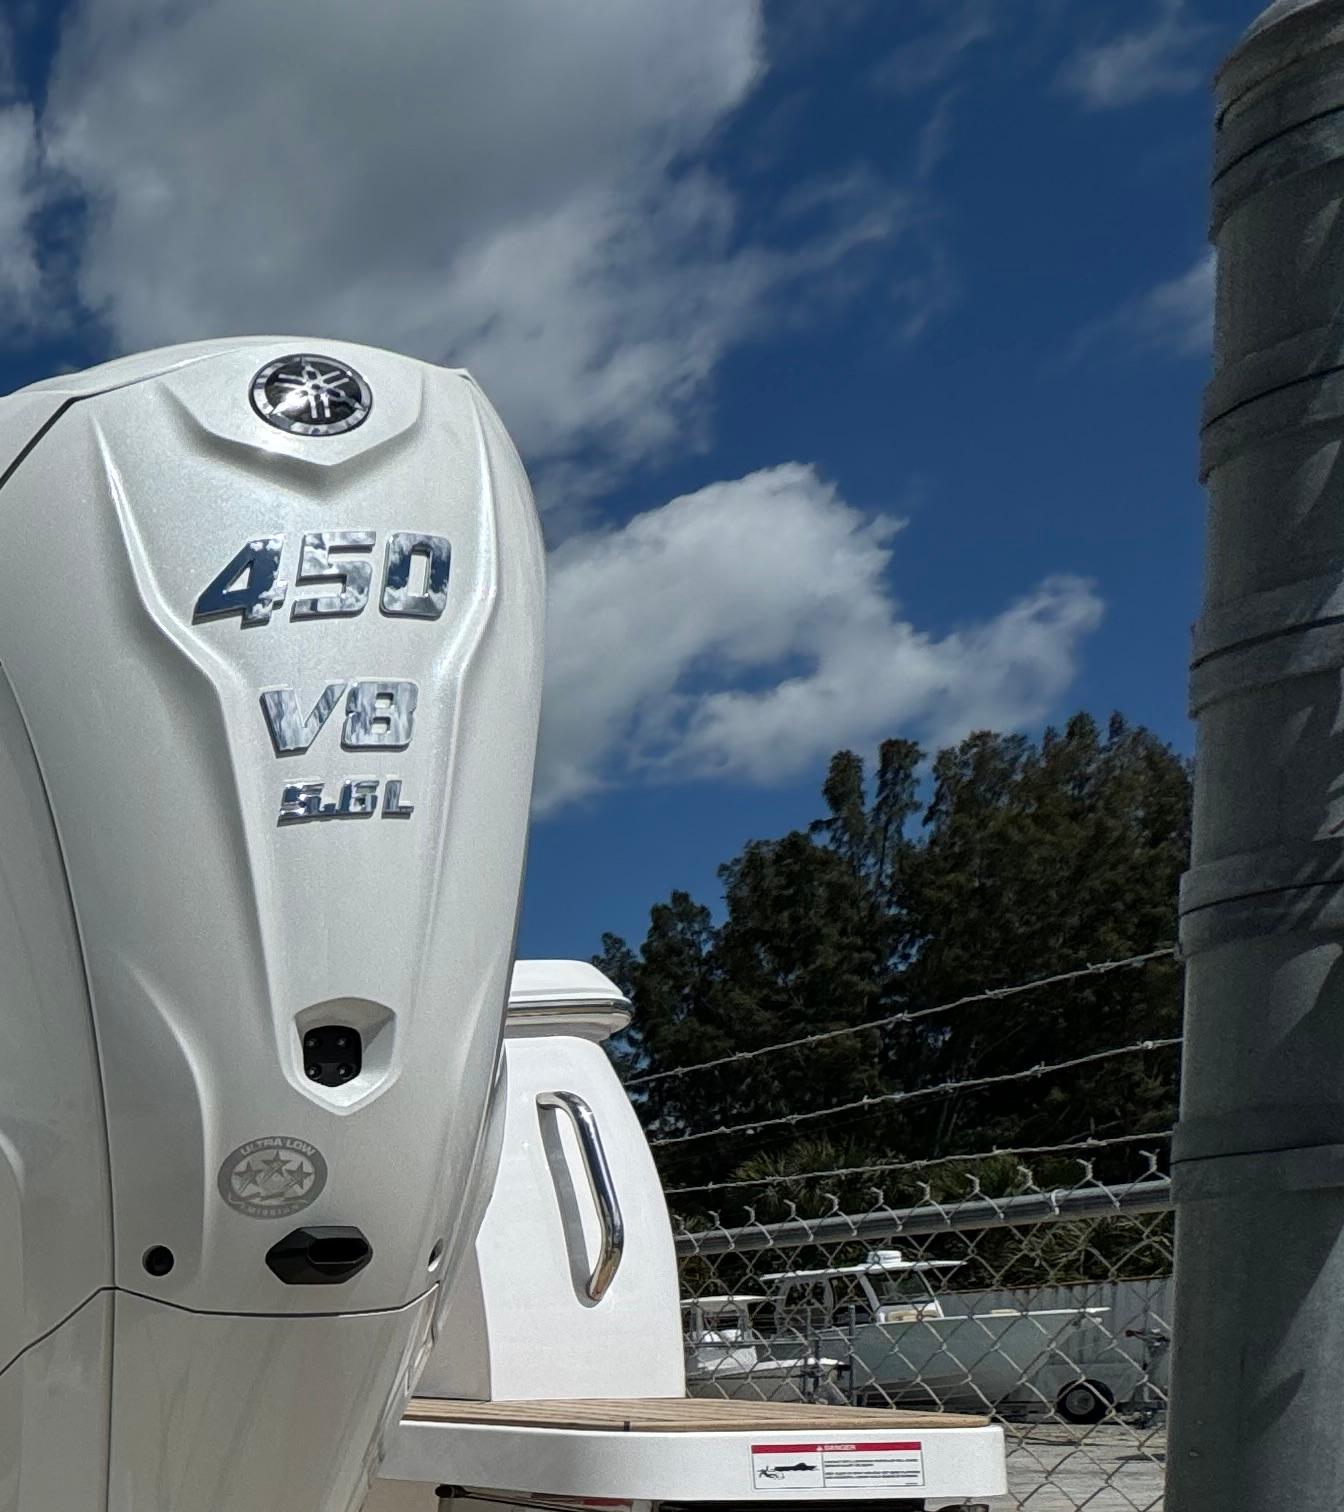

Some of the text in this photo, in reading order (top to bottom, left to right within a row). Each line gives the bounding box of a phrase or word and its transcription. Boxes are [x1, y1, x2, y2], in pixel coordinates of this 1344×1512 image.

[192, 530, 452, 629] 450
[259, 679, 418, 759] V8
[277, 779, 413, 827] 5.6L
[286, 1138, 316, 1156] LOW
